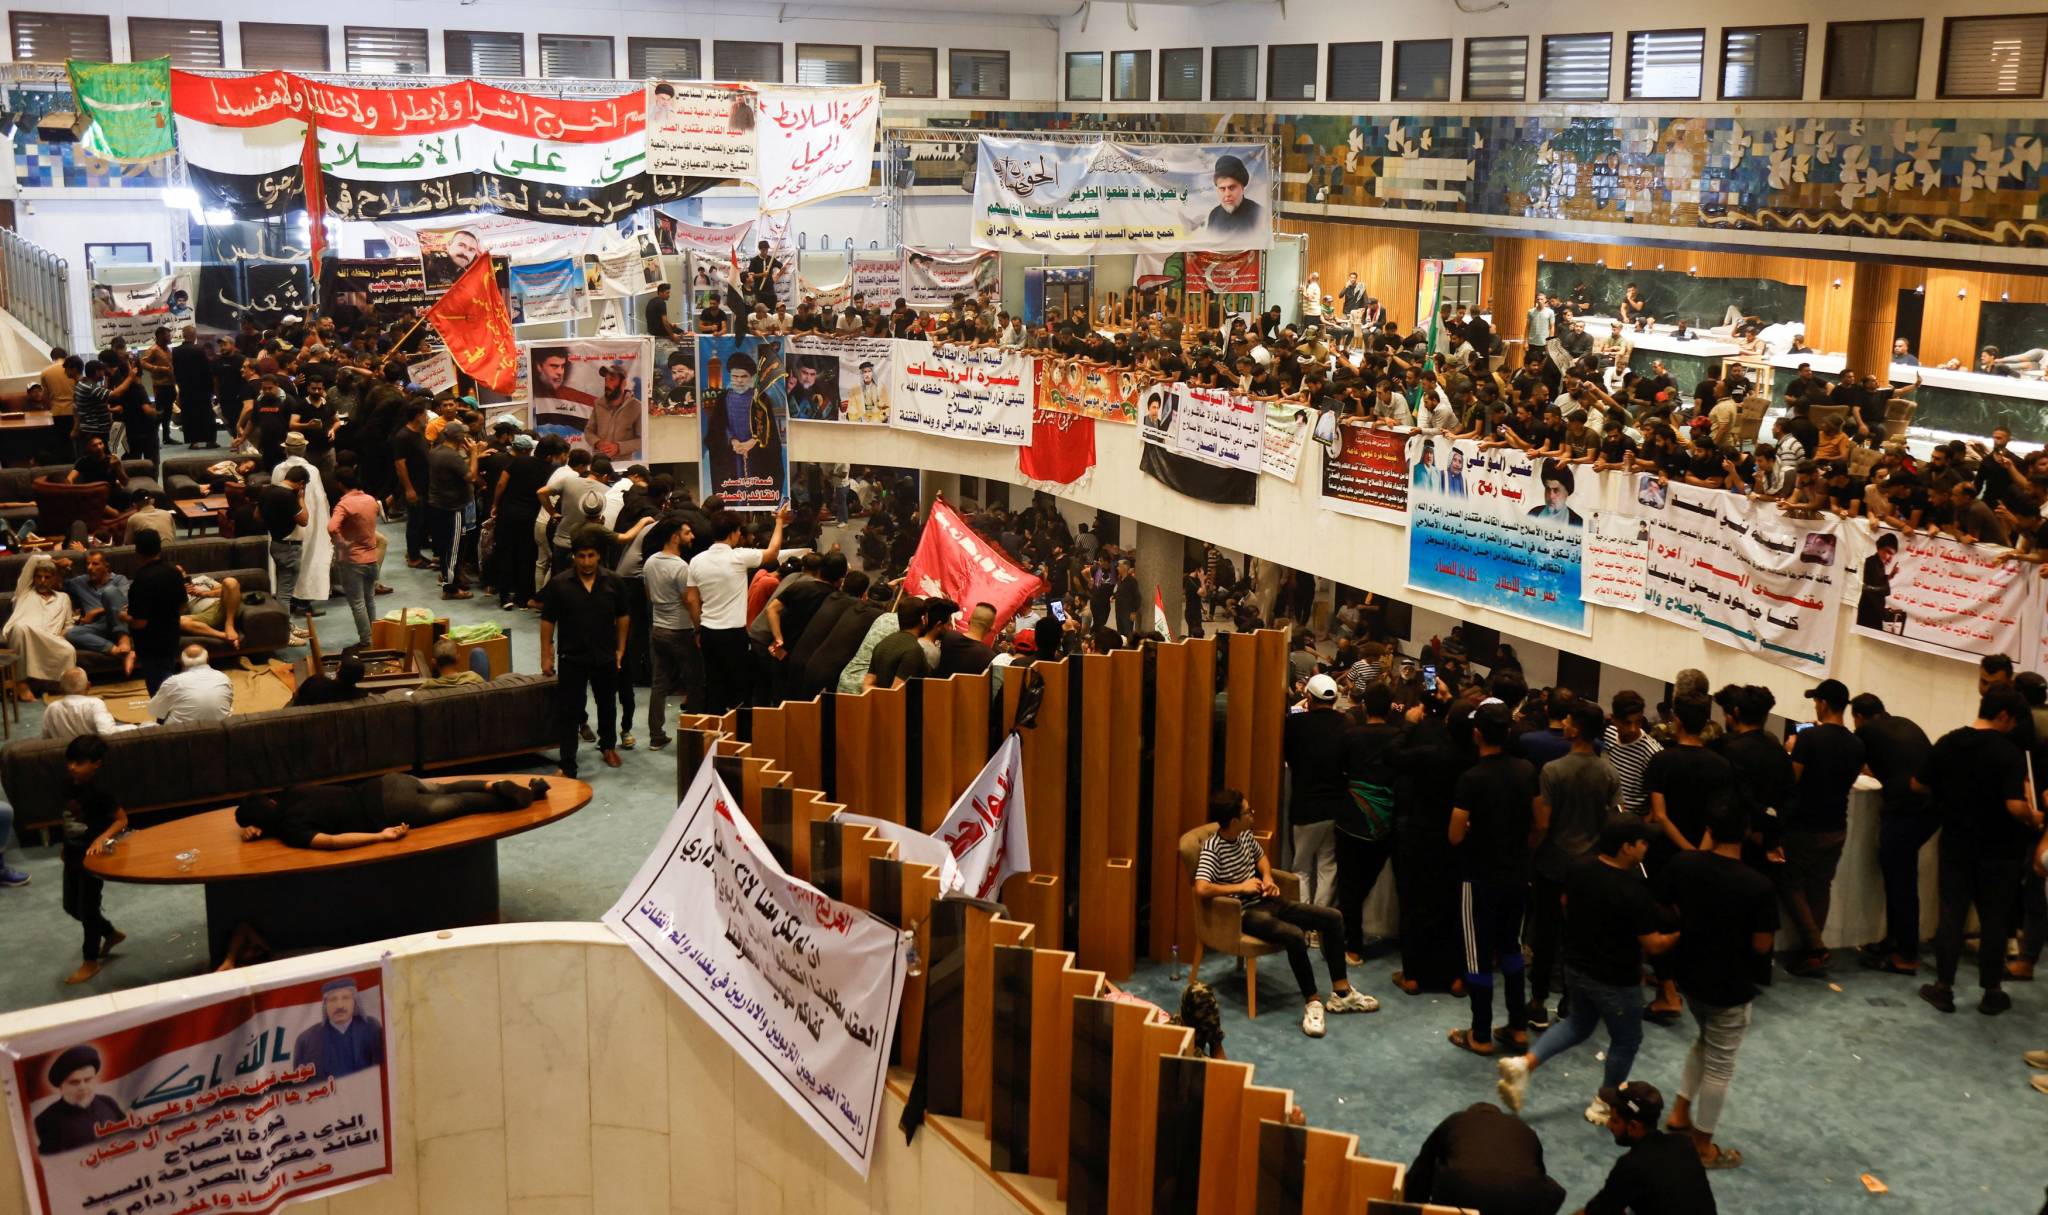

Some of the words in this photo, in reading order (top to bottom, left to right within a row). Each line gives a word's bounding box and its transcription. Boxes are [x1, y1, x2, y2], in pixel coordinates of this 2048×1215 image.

[344, 94, 378, 128] ولا
[533, 102, 617, 138] أخرج
[705, 126, 725, 136] القائد
[456, 176, 529, 212] لطلب
[537, 184, 643, 223] خرجت
[1105, 185, 1129, 201] قطعوا
[1179, 186, 1189, 206] في
[1031, 229, 1052, 241] الصدر
[1083, 229, 1103, 240] القائد
[1105, 229, 1126, 240] السيد
[400, 267, 422, 277] قتدى
[906, 361, 973, 386] الرزيجات
[977, 368, 1020, 389] عشيرة
[951, 388, 972, 401] الصدر
[973, 390, 992, 404] السيد
[899, 410, 922, 424] الفتنة
[941, 415, 967, 432] العراقي
[981, 421, 1002, 436] لحقن
[1196, 441, 1217, 454] الصدر
[1467, 451, 1485, 473] علي
[1445, 509, 1464, 518] الصدر
[1719, 515, 1750, 538] بني
[1690, 556, 1751, 588] الصدر
[1689, 579, 1721, 604] بين
[1751, 584, 1825, 611] مقتدى
[1724, 594, 1763, 621] جنود
[1766, 607, 1799, 631] كلنا
[754, 887, 780, 923] معنا
[771, 911, 802, 943] تكن
[689, 950, 717, 982] بغداد
[712, 971, 731, 992] في
[725, 981, 767, 1032] والاداريين
[766, 1020, 800, 1063] التربويين
[795, 1058, 840, 1105] الخريجين
[244, 1092, 280, 1122] الشيخ
[840, 1093, 865, 1136] رابطة
[248, 1114, 286, 1143] ثورة
[322, 1126, 381, 1157] القائد
[156, 1151, 232, 1184] سماحة
[235, 1146, 263, 1164] لها
[251, 1145, 317, 1185] مقتدى
[184, 1168, 248, 1198] الصدر
[291, 1160, 335, 1184] ضد
[81, 1174, 152, 1210] السيد
